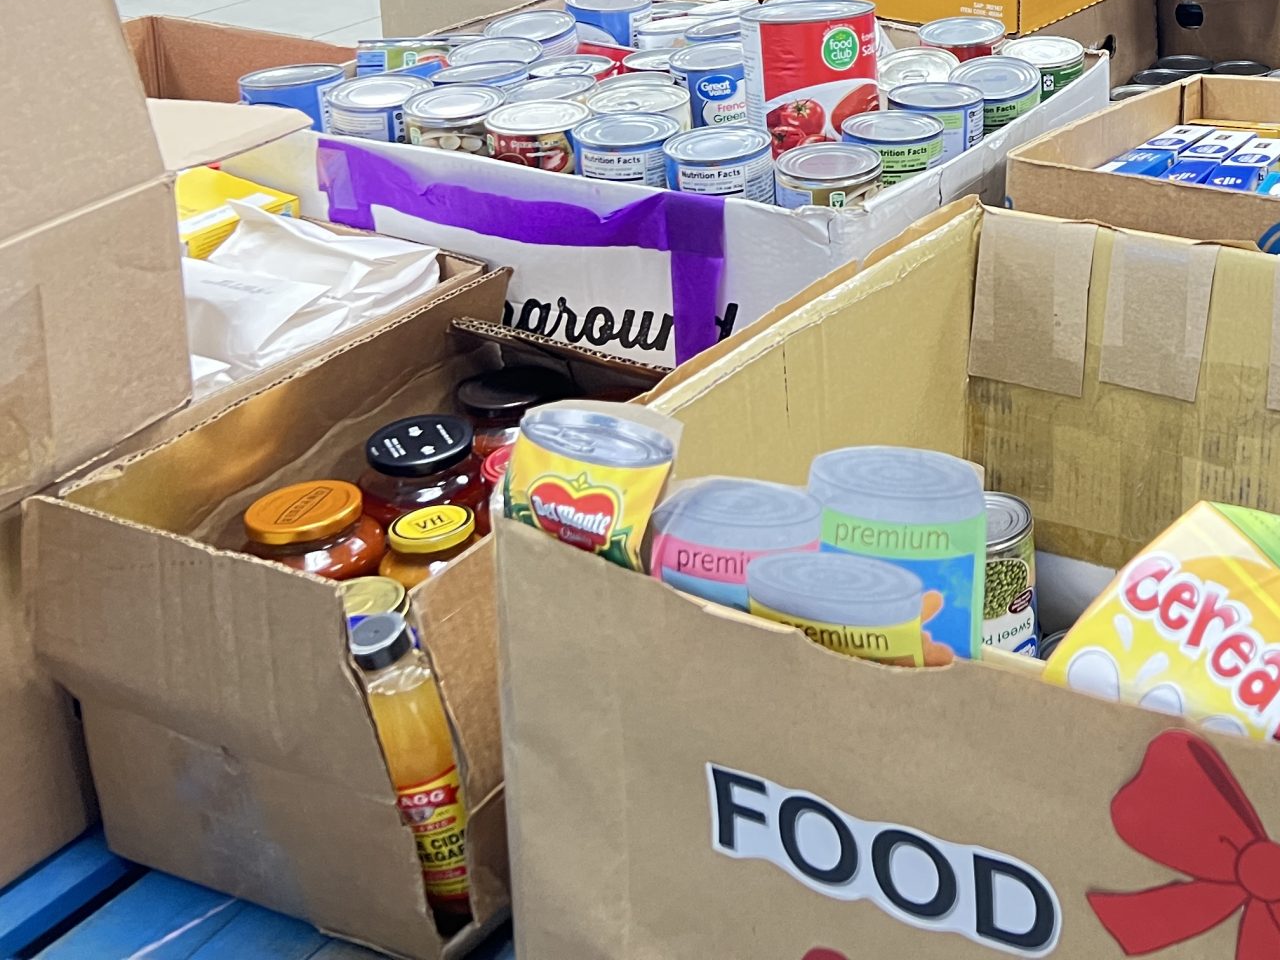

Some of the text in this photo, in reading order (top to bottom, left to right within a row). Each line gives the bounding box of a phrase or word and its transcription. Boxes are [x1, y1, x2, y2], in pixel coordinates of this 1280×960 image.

[829, 38, 853, 50] food
[830, 47, 852, 59] club
[701, 80, 730, 91] Great
[708, 88, 731, 96] Value
[717, 102, 745, 112] Frenc
[996, 104, 1016, 112] Facts
[713, 112, 746, 123] Green
[880, 147, 927, 157] trition Facts
[584, 154, 641, 164] Nutrition Facts
[682, 168, 741, 180] Nutrition Facts
[532, 495, 611, 536] Del Monte
[415, 514, 445, 530] VH
[835, 520, 951, 552] premium
[780, 618, 889, 653] remium
[997, 617, 1031, 644] Sweet
[712, 767, 1054, 948] FOOD
